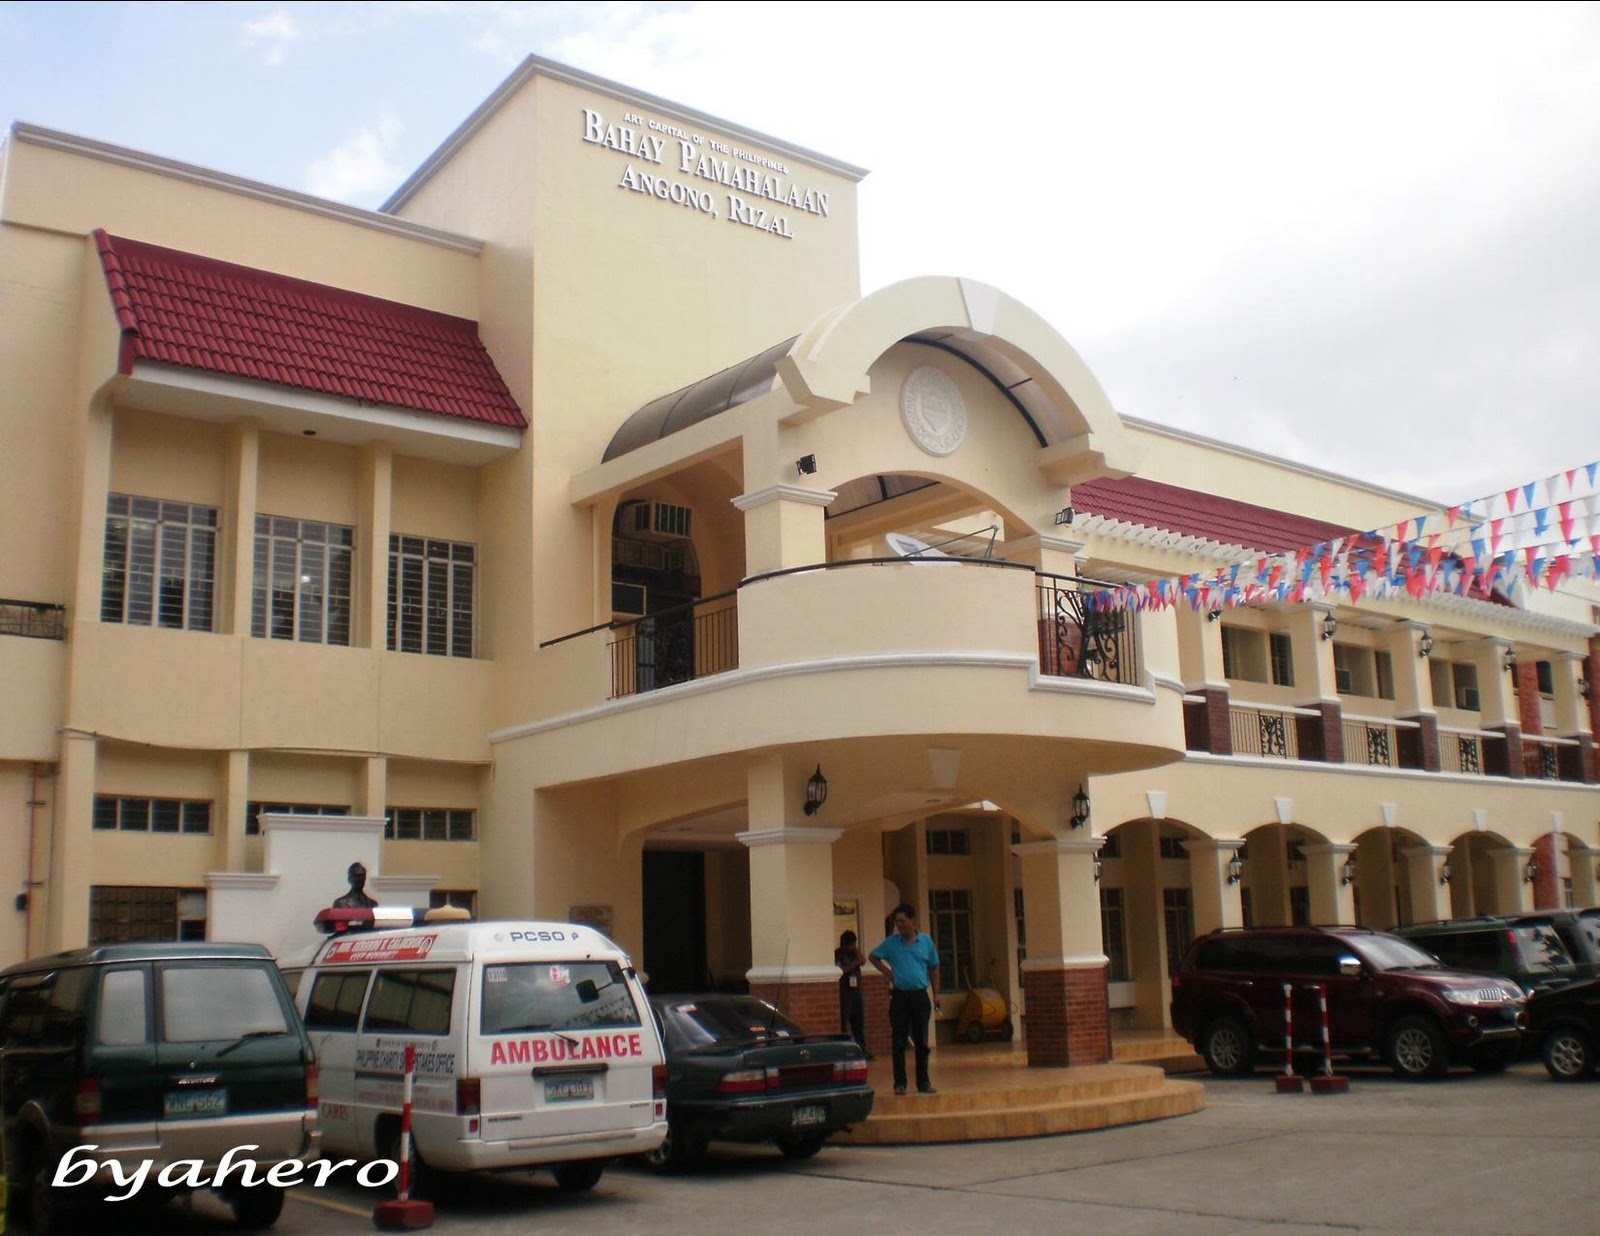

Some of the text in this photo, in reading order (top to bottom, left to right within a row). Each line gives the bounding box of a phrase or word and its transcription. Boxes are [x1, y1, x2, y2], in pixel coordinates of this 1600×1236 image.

[583, 109, 829, 218] BAHAY PAMAHALAAN
[624, 112, 790, 175] ART CAPITAL OF THE PHILIPPINES
[618, 164, 794, 239] ANGONO, RIZAL
[510, 931, 565, 943] PCSO
[490, 1034, 643, 1066] AMBULANCE
